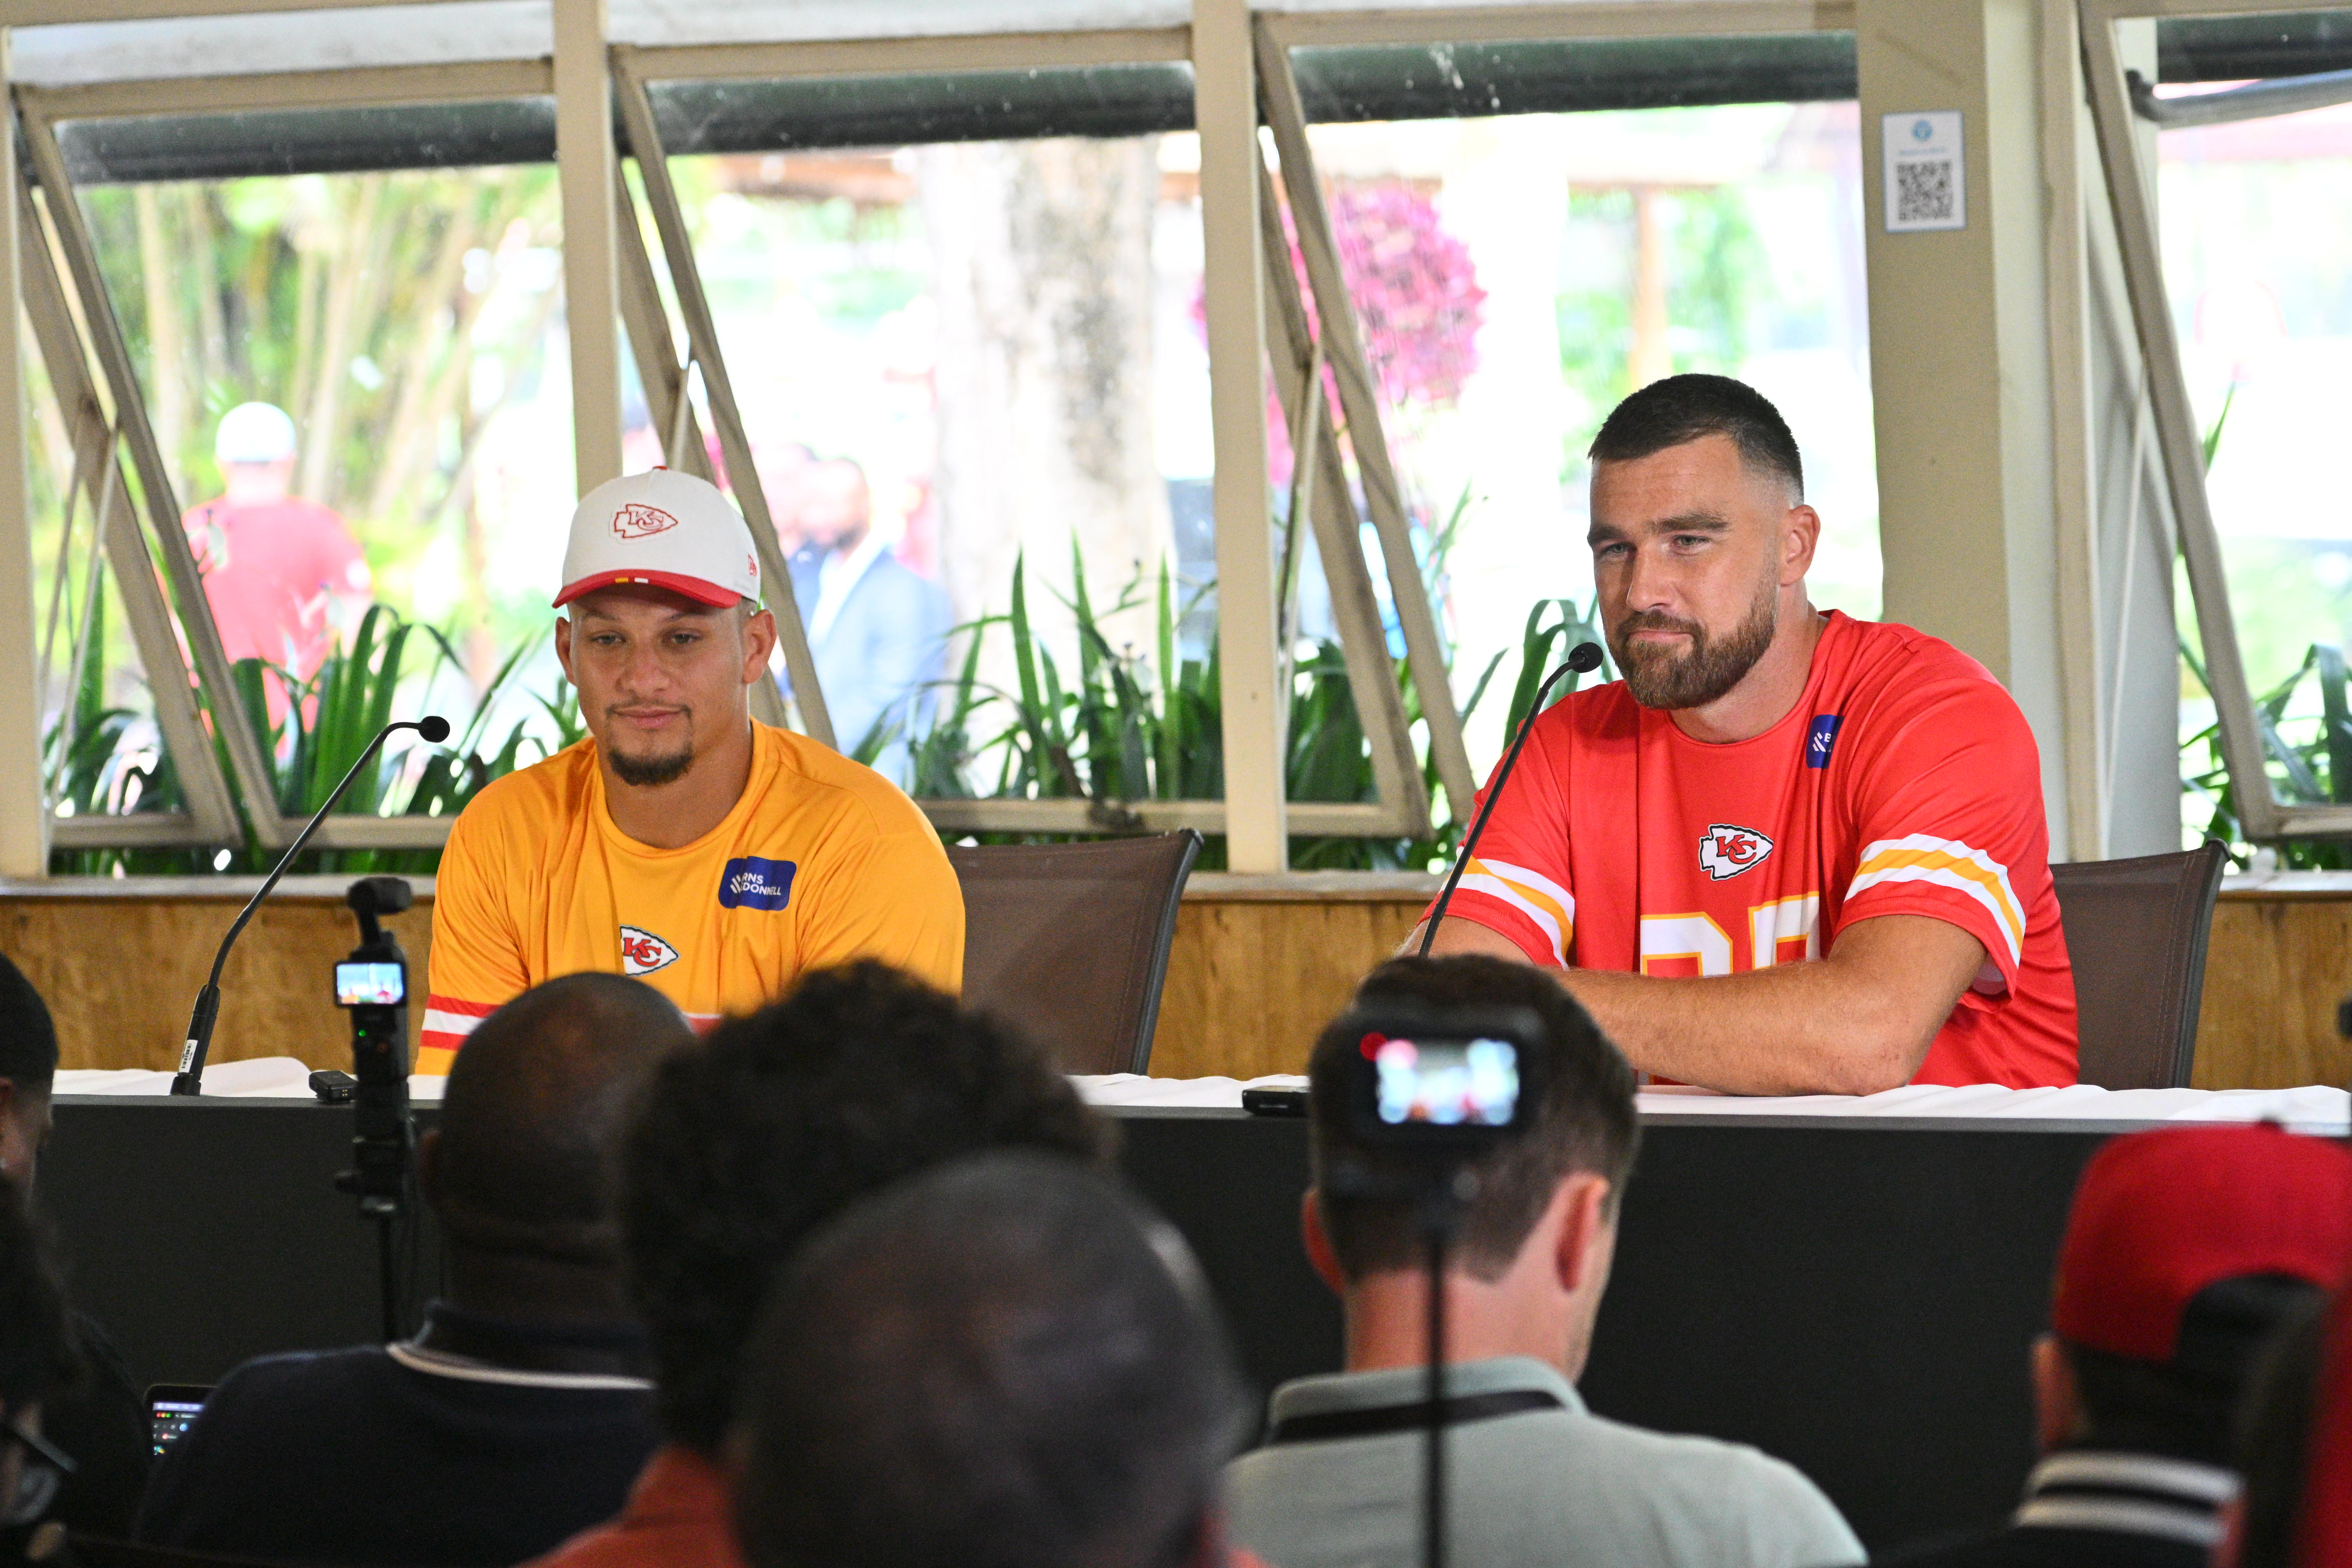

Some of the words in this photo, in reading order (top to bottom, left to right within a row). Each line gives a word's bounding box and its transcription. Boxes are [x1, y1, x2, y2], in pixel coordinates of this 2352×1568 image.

[628, 510, 663, 531] KC
[1715, 834, 1757, 865] KC
[741, 872, 763, 885] RNS
[741, 881, 781, 896] DONNELL
[622, 937, 662, 967] KC
